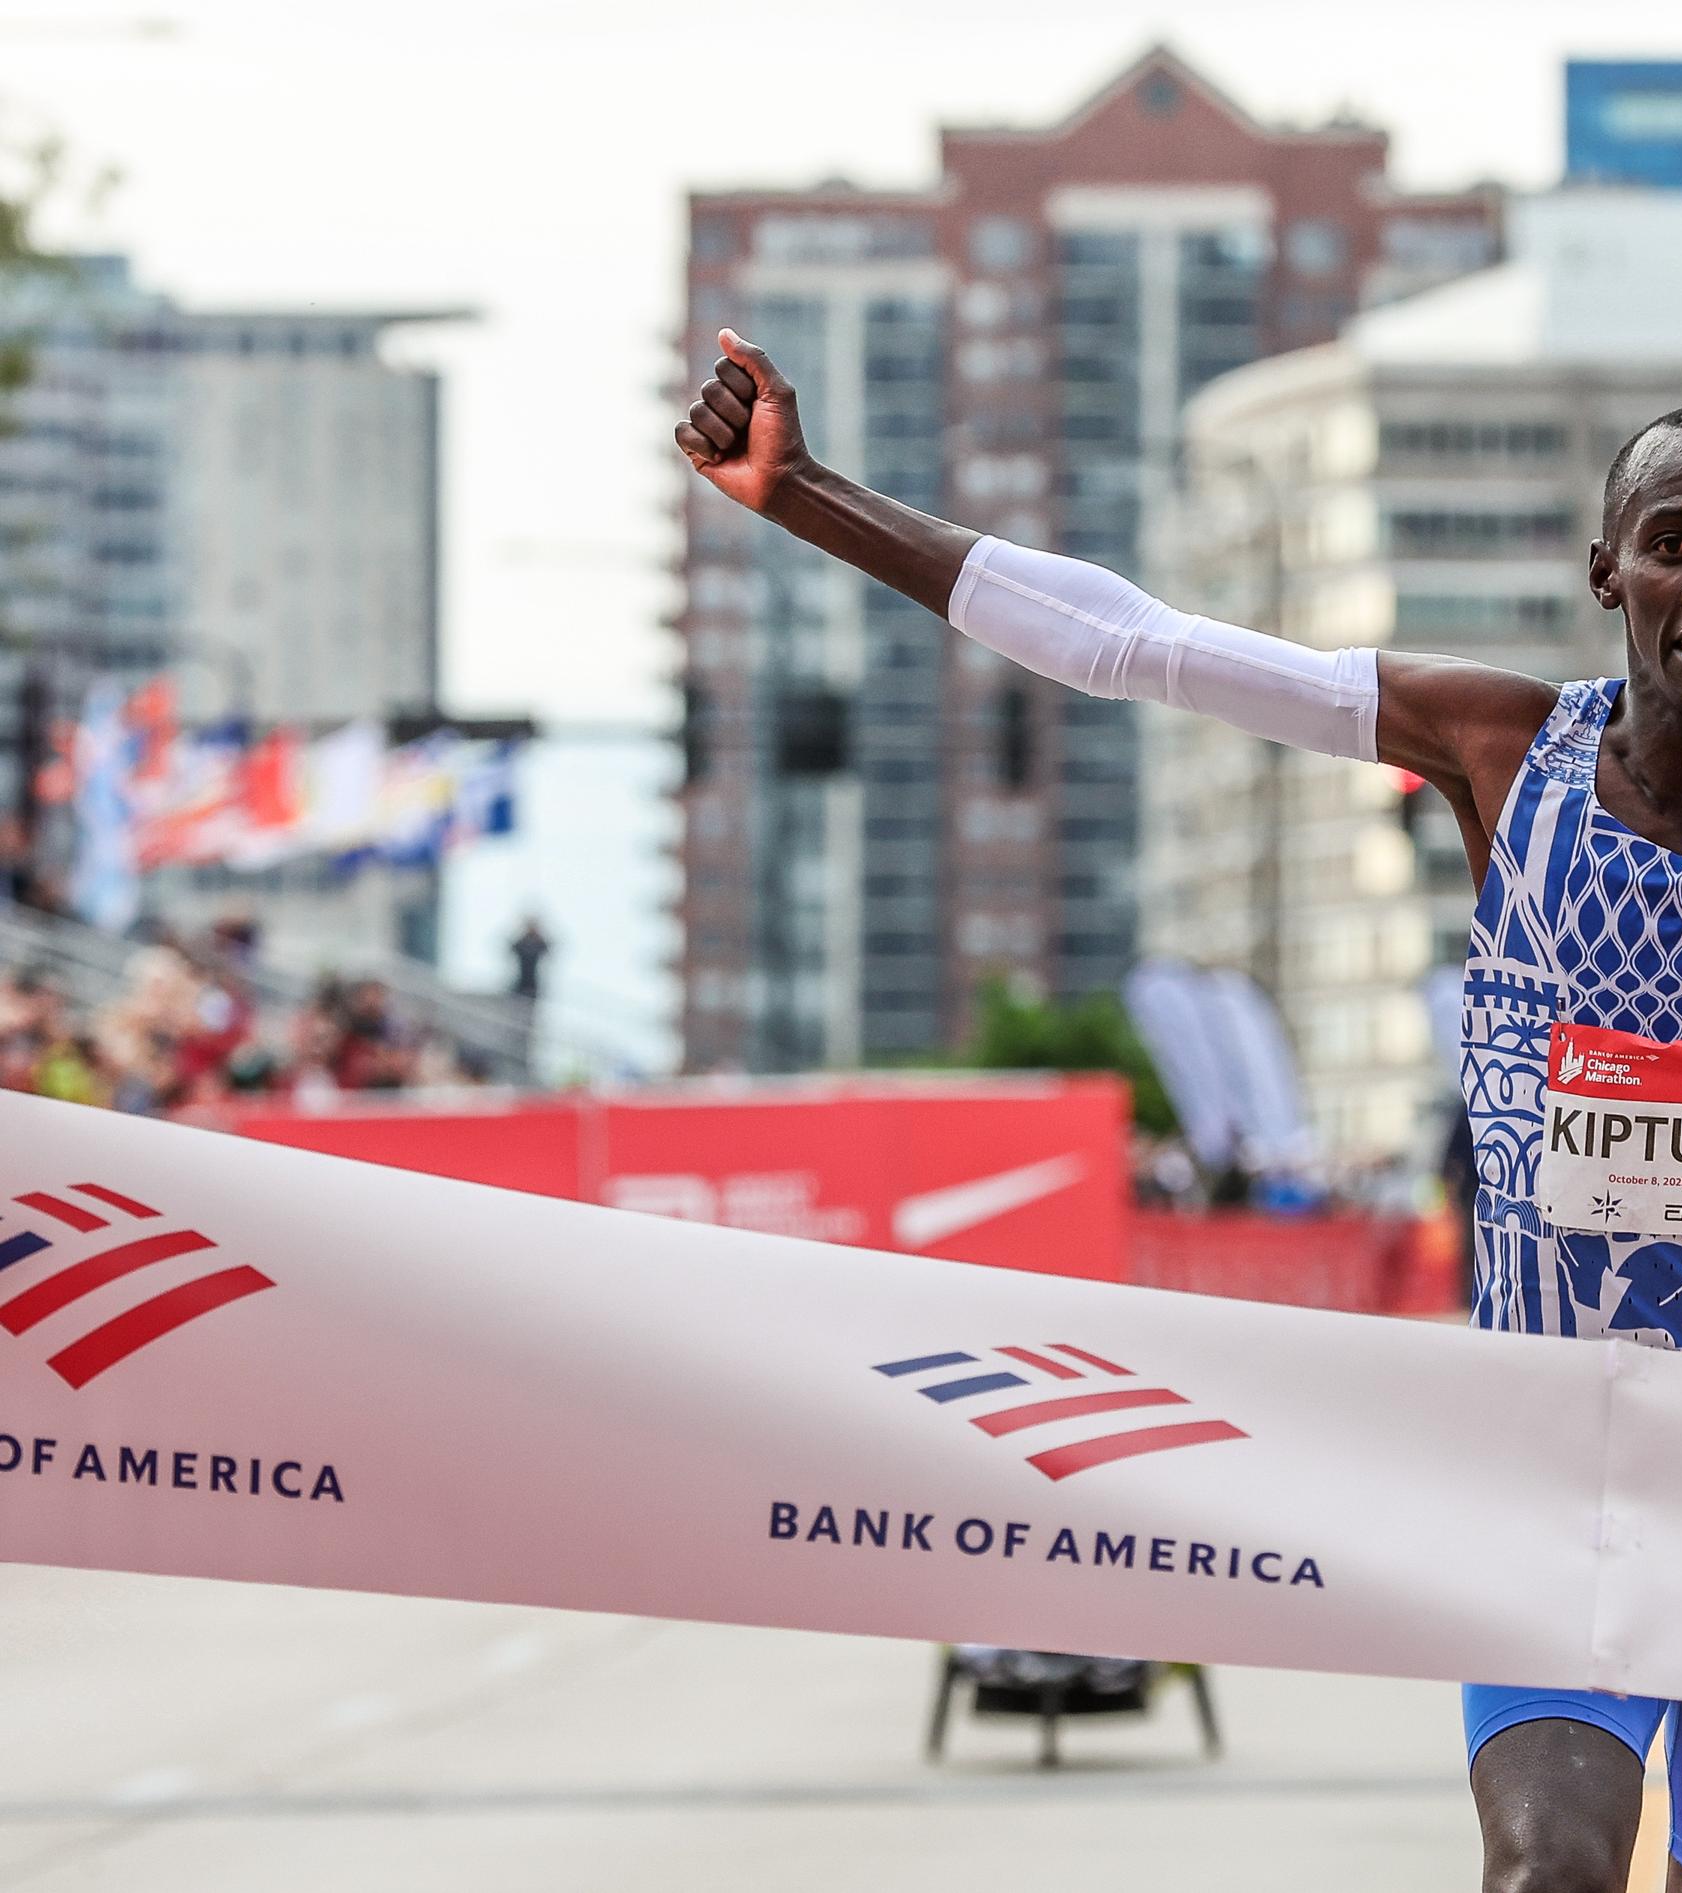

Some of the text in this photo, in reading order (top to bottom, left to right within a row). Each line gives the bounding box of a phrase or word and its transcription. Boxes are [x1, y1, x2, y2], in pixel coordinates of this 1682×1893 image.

[1587, 1059, 1630, 1074] Chicago
[1608, 1174, 1649, 1186] October
[1651, 1176, 1660, 1187] 8,
[0, 1433, 345, 1503] OF AMERICA
[768, 1500, 1326, 1589] BANK OF AMERICA
